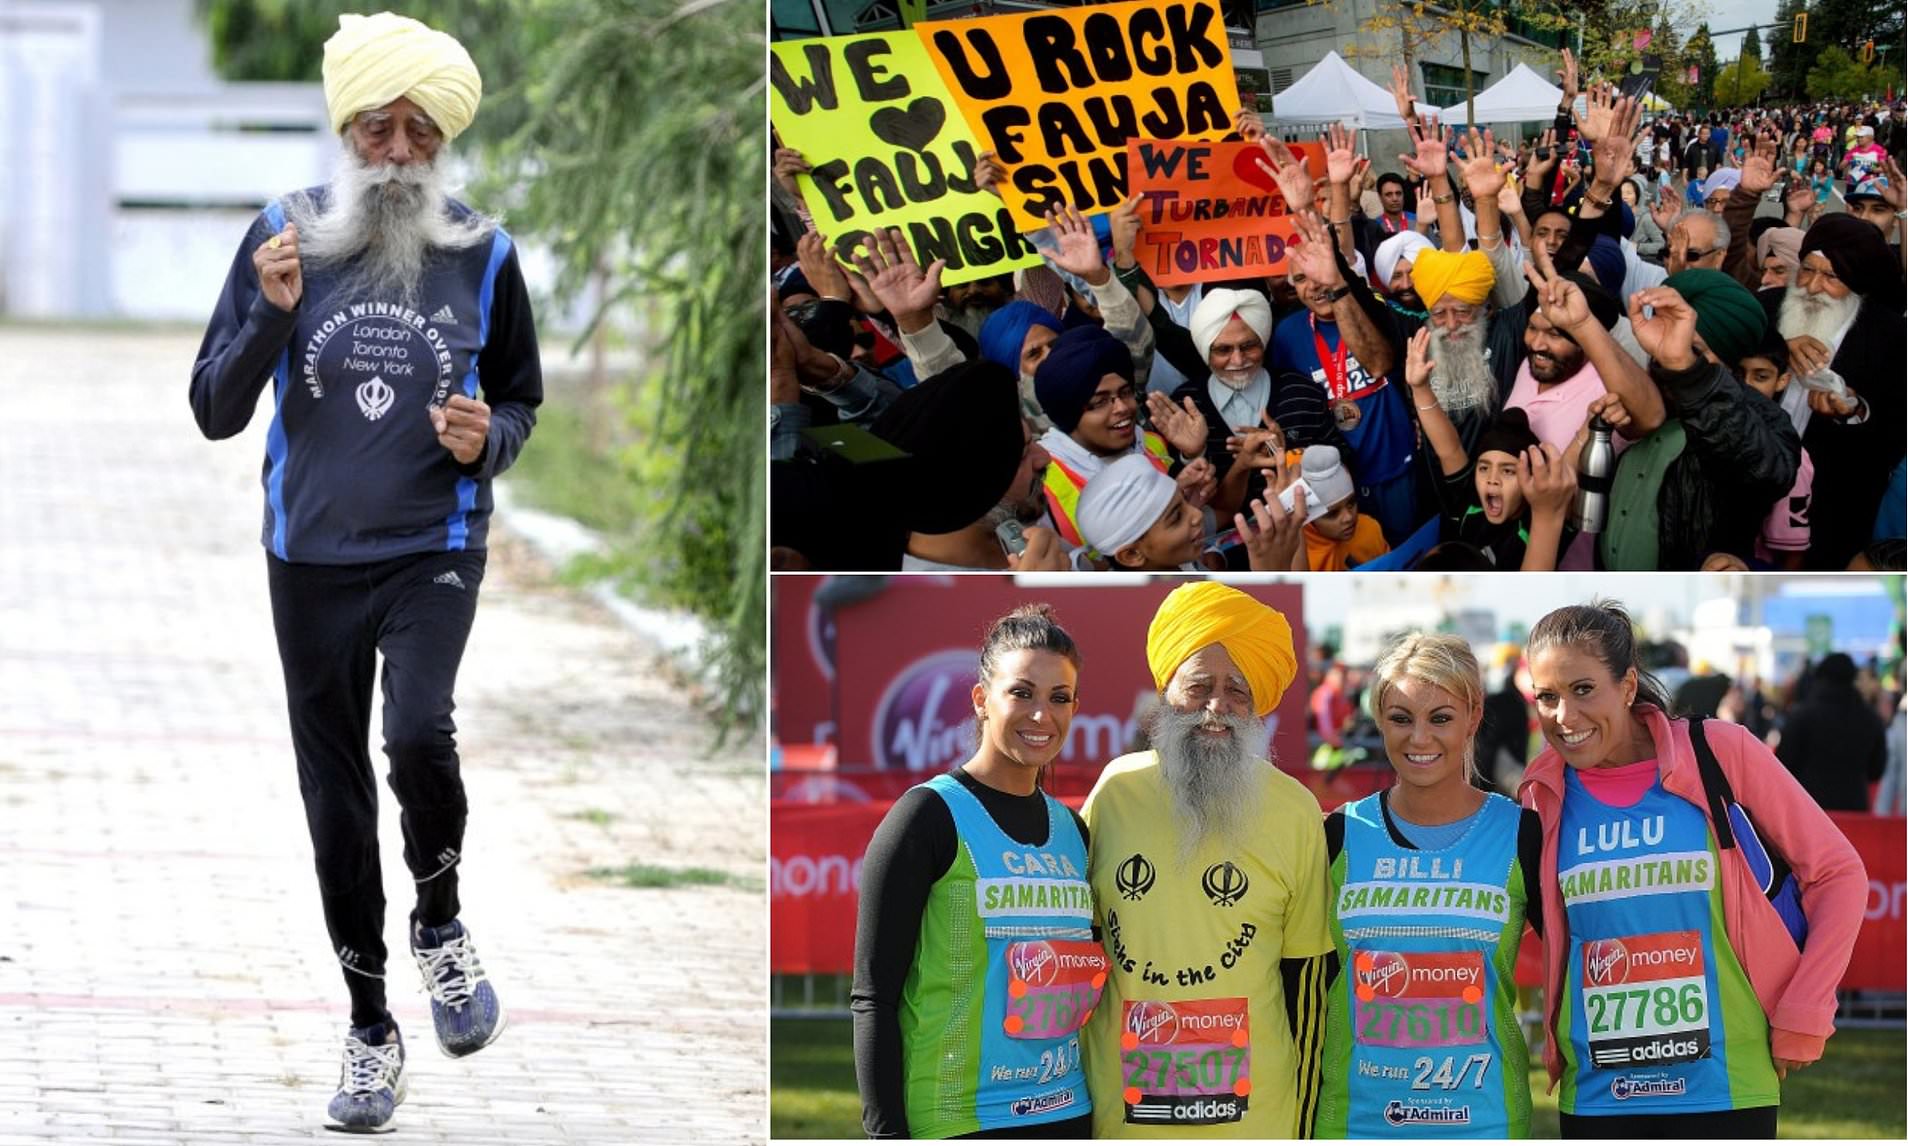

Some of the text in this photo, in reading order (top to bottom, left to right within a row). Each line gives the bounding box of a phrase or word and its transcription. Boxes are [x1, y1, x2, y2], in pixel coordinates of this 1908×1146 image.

[933, 2, 1223, 100] U ROCK
[771, 38, 912, 116] WE
[982, 81, 1231, 164] FAUJA
[812, 140, 982, 222] FAUJ
[1139, 144, 1211, 180] WE
[1012, 152, 1129, 219] SIN
[304, 311, 348, 398] MARATHON
[350, 302, 426, 329] WINNER
[426, 328, 452, 374] OVER
[352, 341, 408, 359] Toronto
[353, 323, 411, 342] London
[343, 357, 415, 376] New York
[1578, 815, 1664, 855] LULU
[1002, 851, 1079, 877] CARA
[1373, 857, 1463, 879] BILLI
[1341, 886, 1506, 914] SAMARITANS
[1016, 943, 1105, 982] Virgin money
[1143, 962, 1169, 985] in
[1176, 965, 1216, 986] the
[1361, 955, 1480, 993] Virgin money
[1589, 943, 1697, 983] Virgin money
[1131, 1002, 1244, 1042] Virgin money
[1361, 1002, 1480, 1041] 27610
[1588, 983, 1703, 1033] 27786
[1125, 1048, 1247, 1088] 27507
[1632, 1040, 1698, 1060] adidas
[1358, 1053, 1492, 1090] We run 24/7
[1633, 1079, 1684, 1093] Admiral
[1174, 1100, 1237, 1119] adidas
[1411, 1106, 1469, 1120] Admiral
